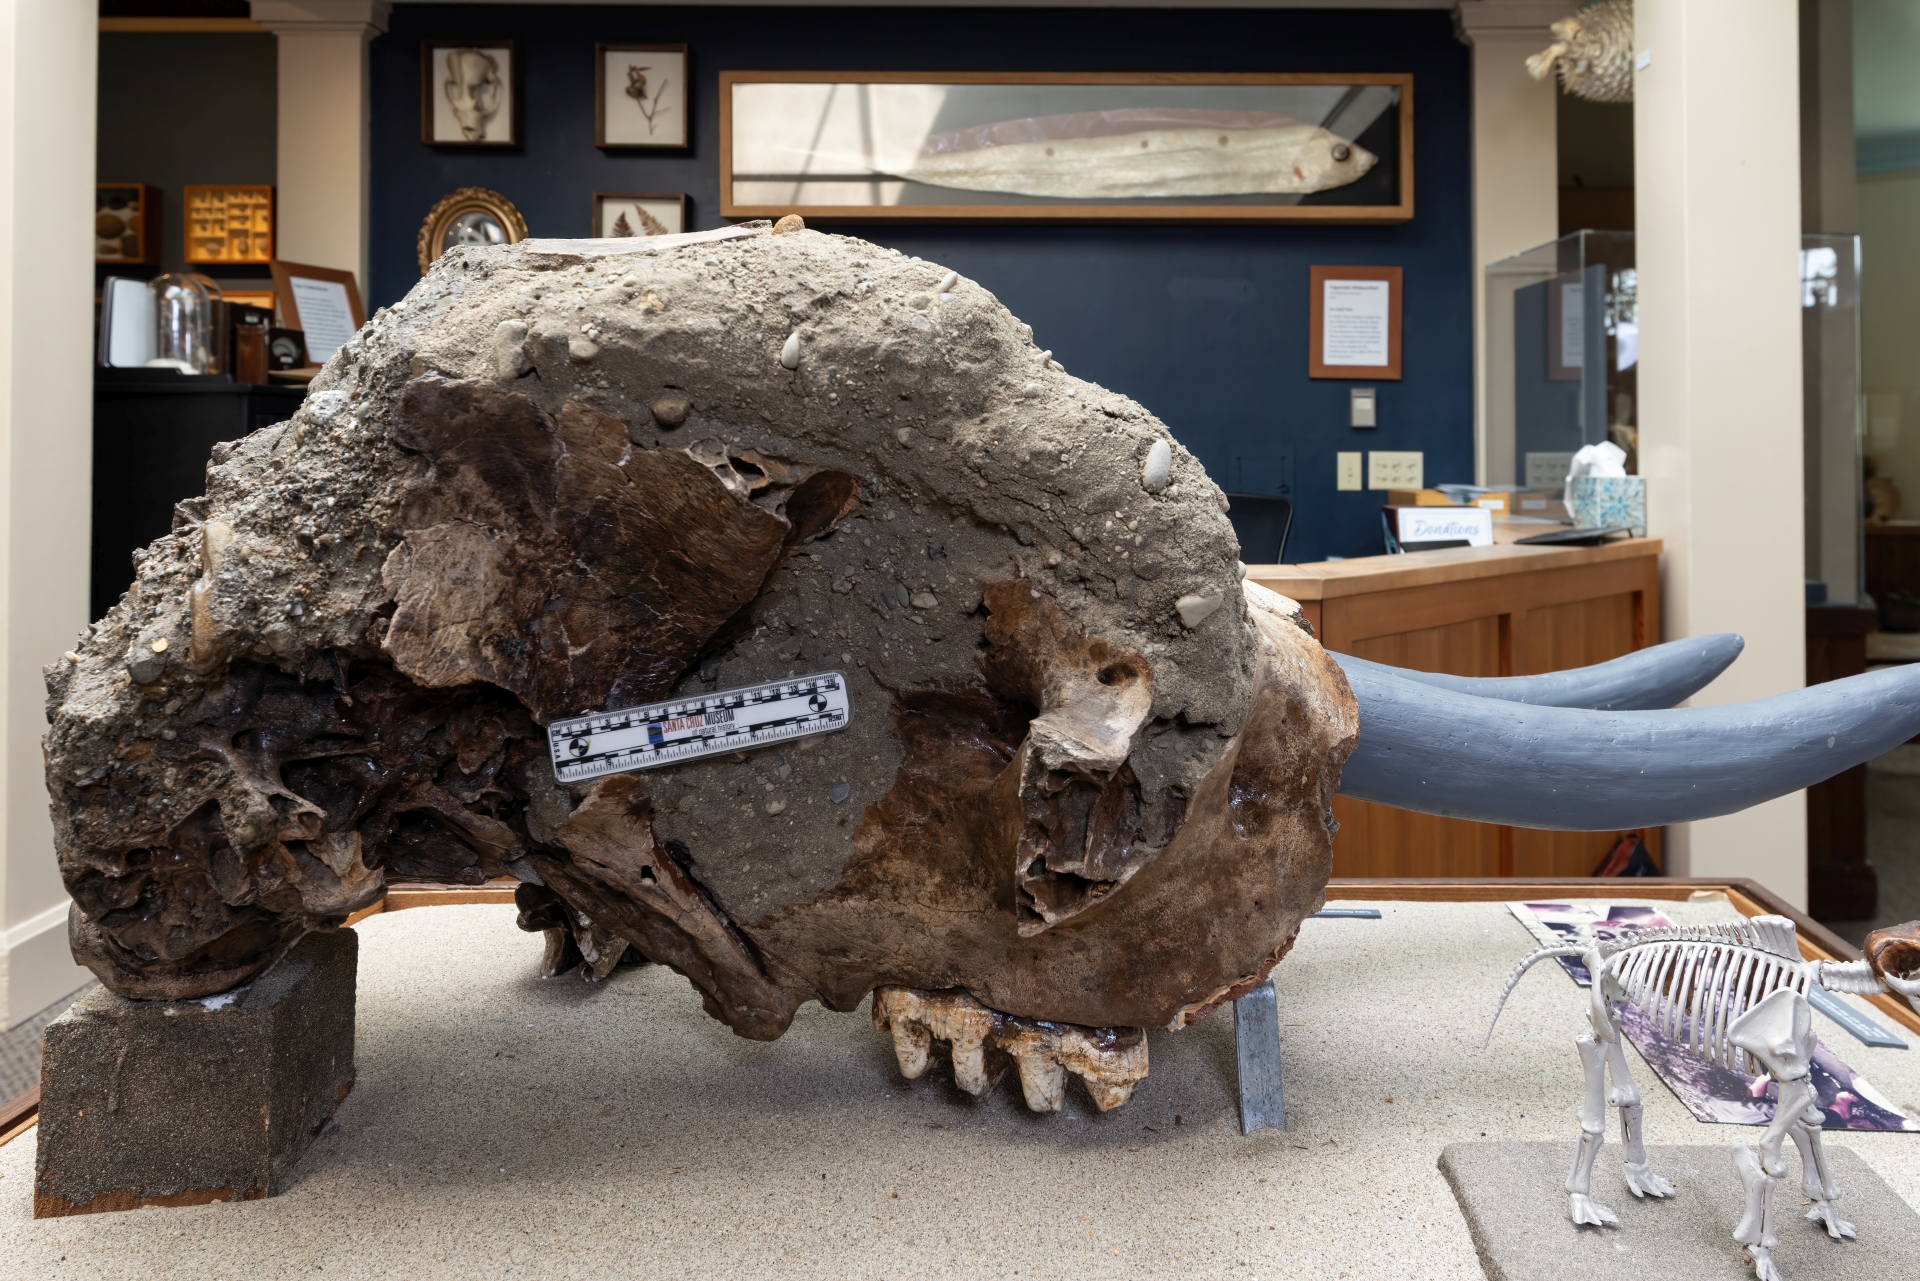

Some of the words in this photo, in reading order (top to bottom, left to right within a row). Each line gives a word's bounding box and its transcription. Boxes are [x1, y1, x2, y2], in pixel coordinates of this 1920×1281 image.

[1413, 519, 1480, 538] Donations
[663, 719, 685, 733] SANTA
[686, 714, 704, 729] CRUZ
[704, 709, 735, 726] MUSEUM
[551, 728, 560, 736] CM
[699, 725, 716, 735] natural
[717, 723, 735, 733] history
